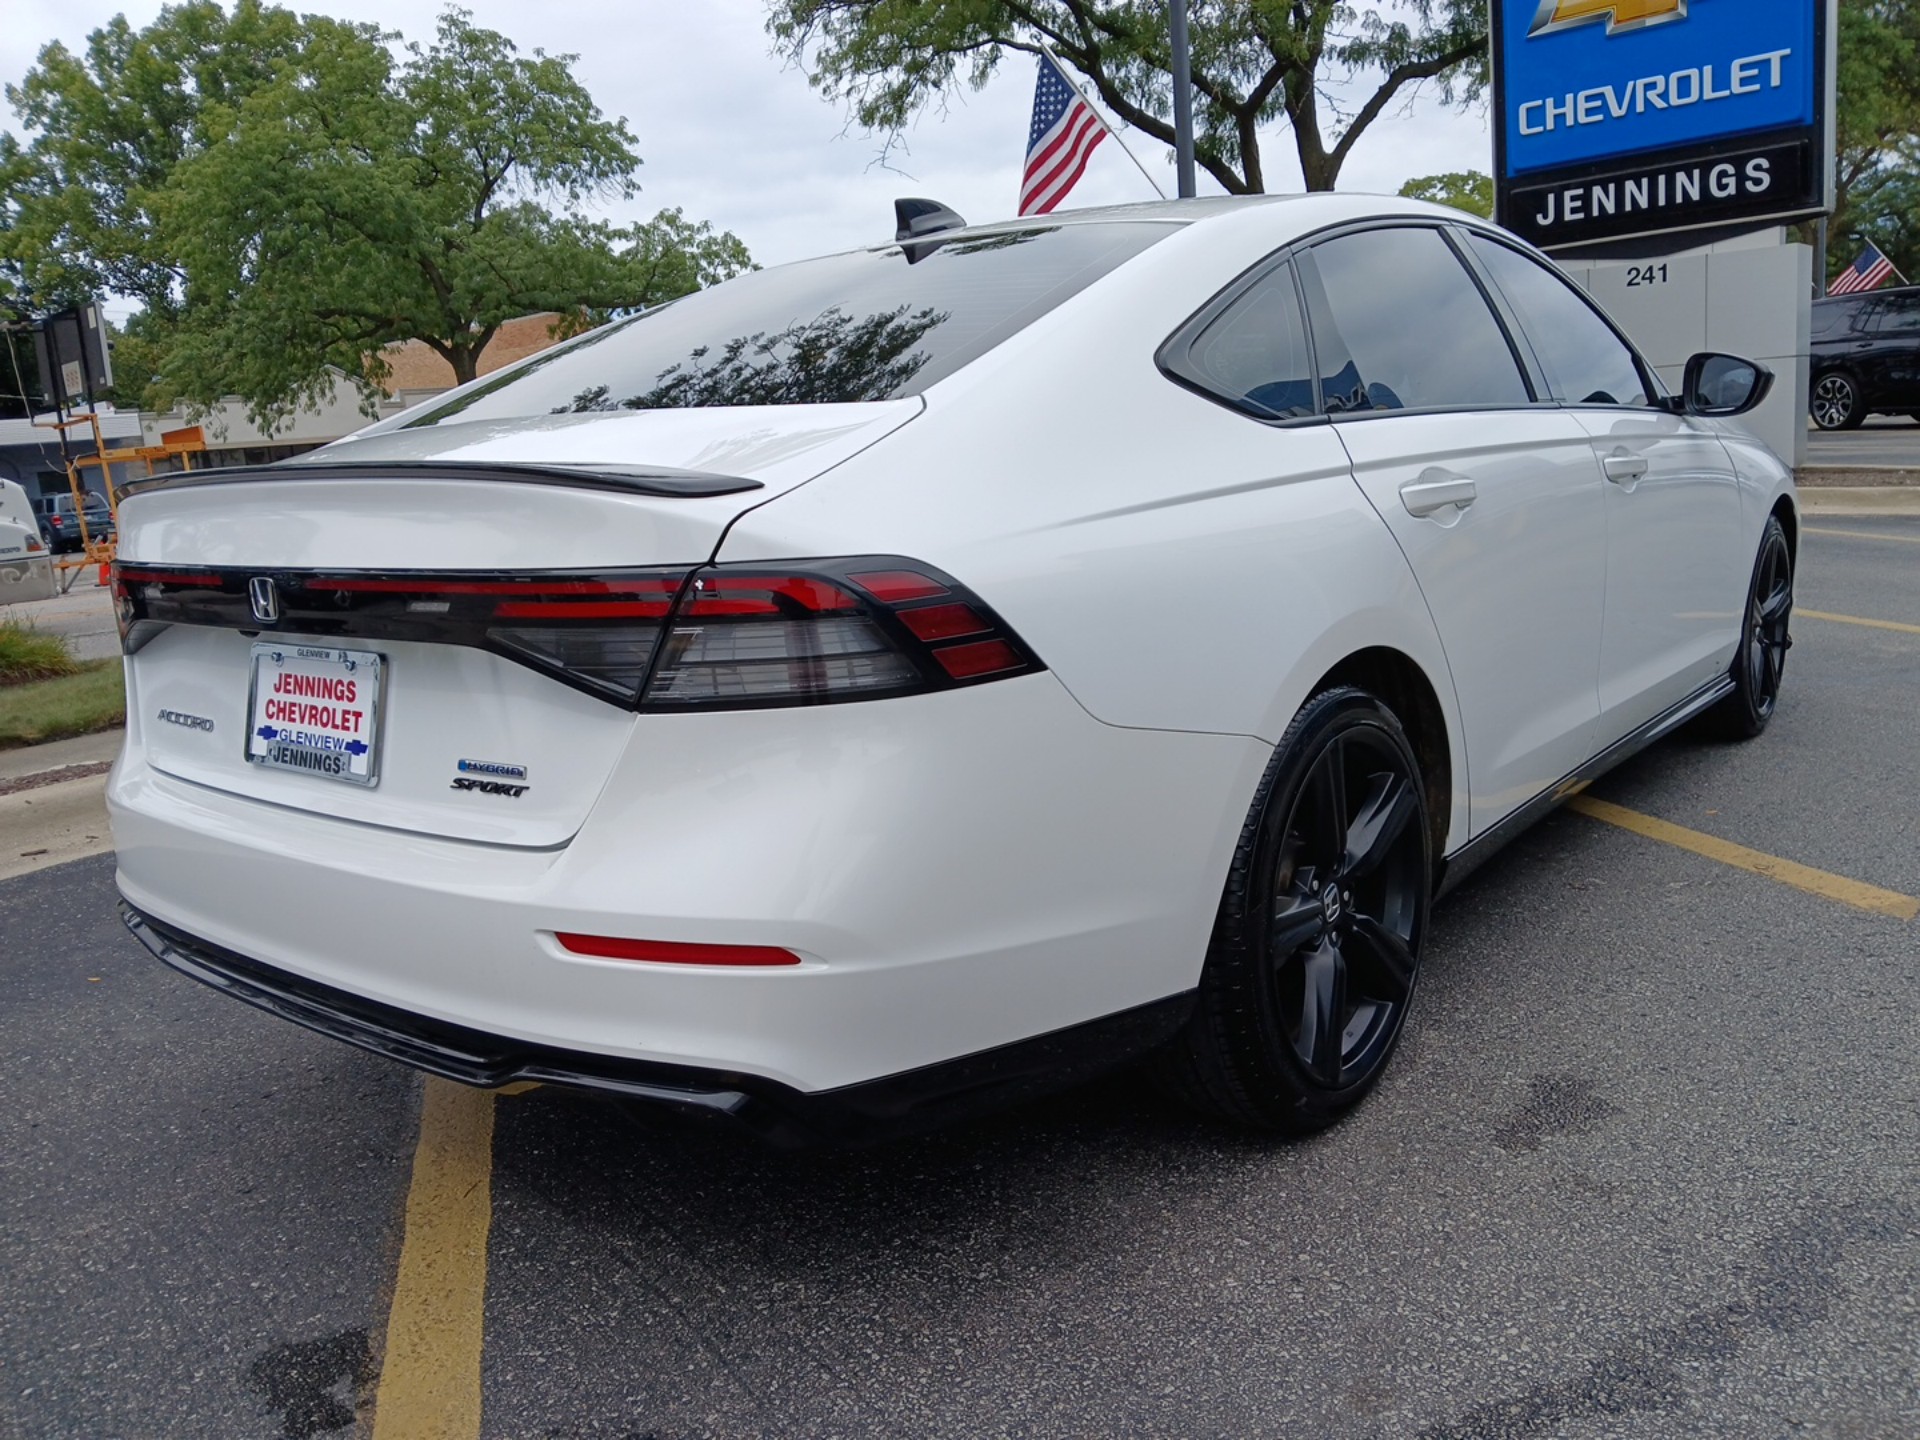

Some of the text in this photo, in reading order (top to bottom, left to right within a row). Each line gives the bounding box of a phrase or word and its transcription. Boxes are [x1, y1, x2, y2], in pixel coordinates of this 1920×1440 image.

[1518, 48, 1792, 137] CHEVROLET
[1536, 157, 1772, 227] JENNINGS
[1626, 263, 1669, 287] 241
[296, 647, 331, 660] GLENVIEW
[273, 672, 357, 703] JENNINGS
[157, 708, 214, 733] ACCORD
[265, 698, 363, 733] CHEVROLET
[279, 728, 345, 750] GLENVIEW
[272, 746, 341, 774] JENNINGS
[467, 761, 524, 777] HYBRID
[449, 777, 530, 798] SPORT
